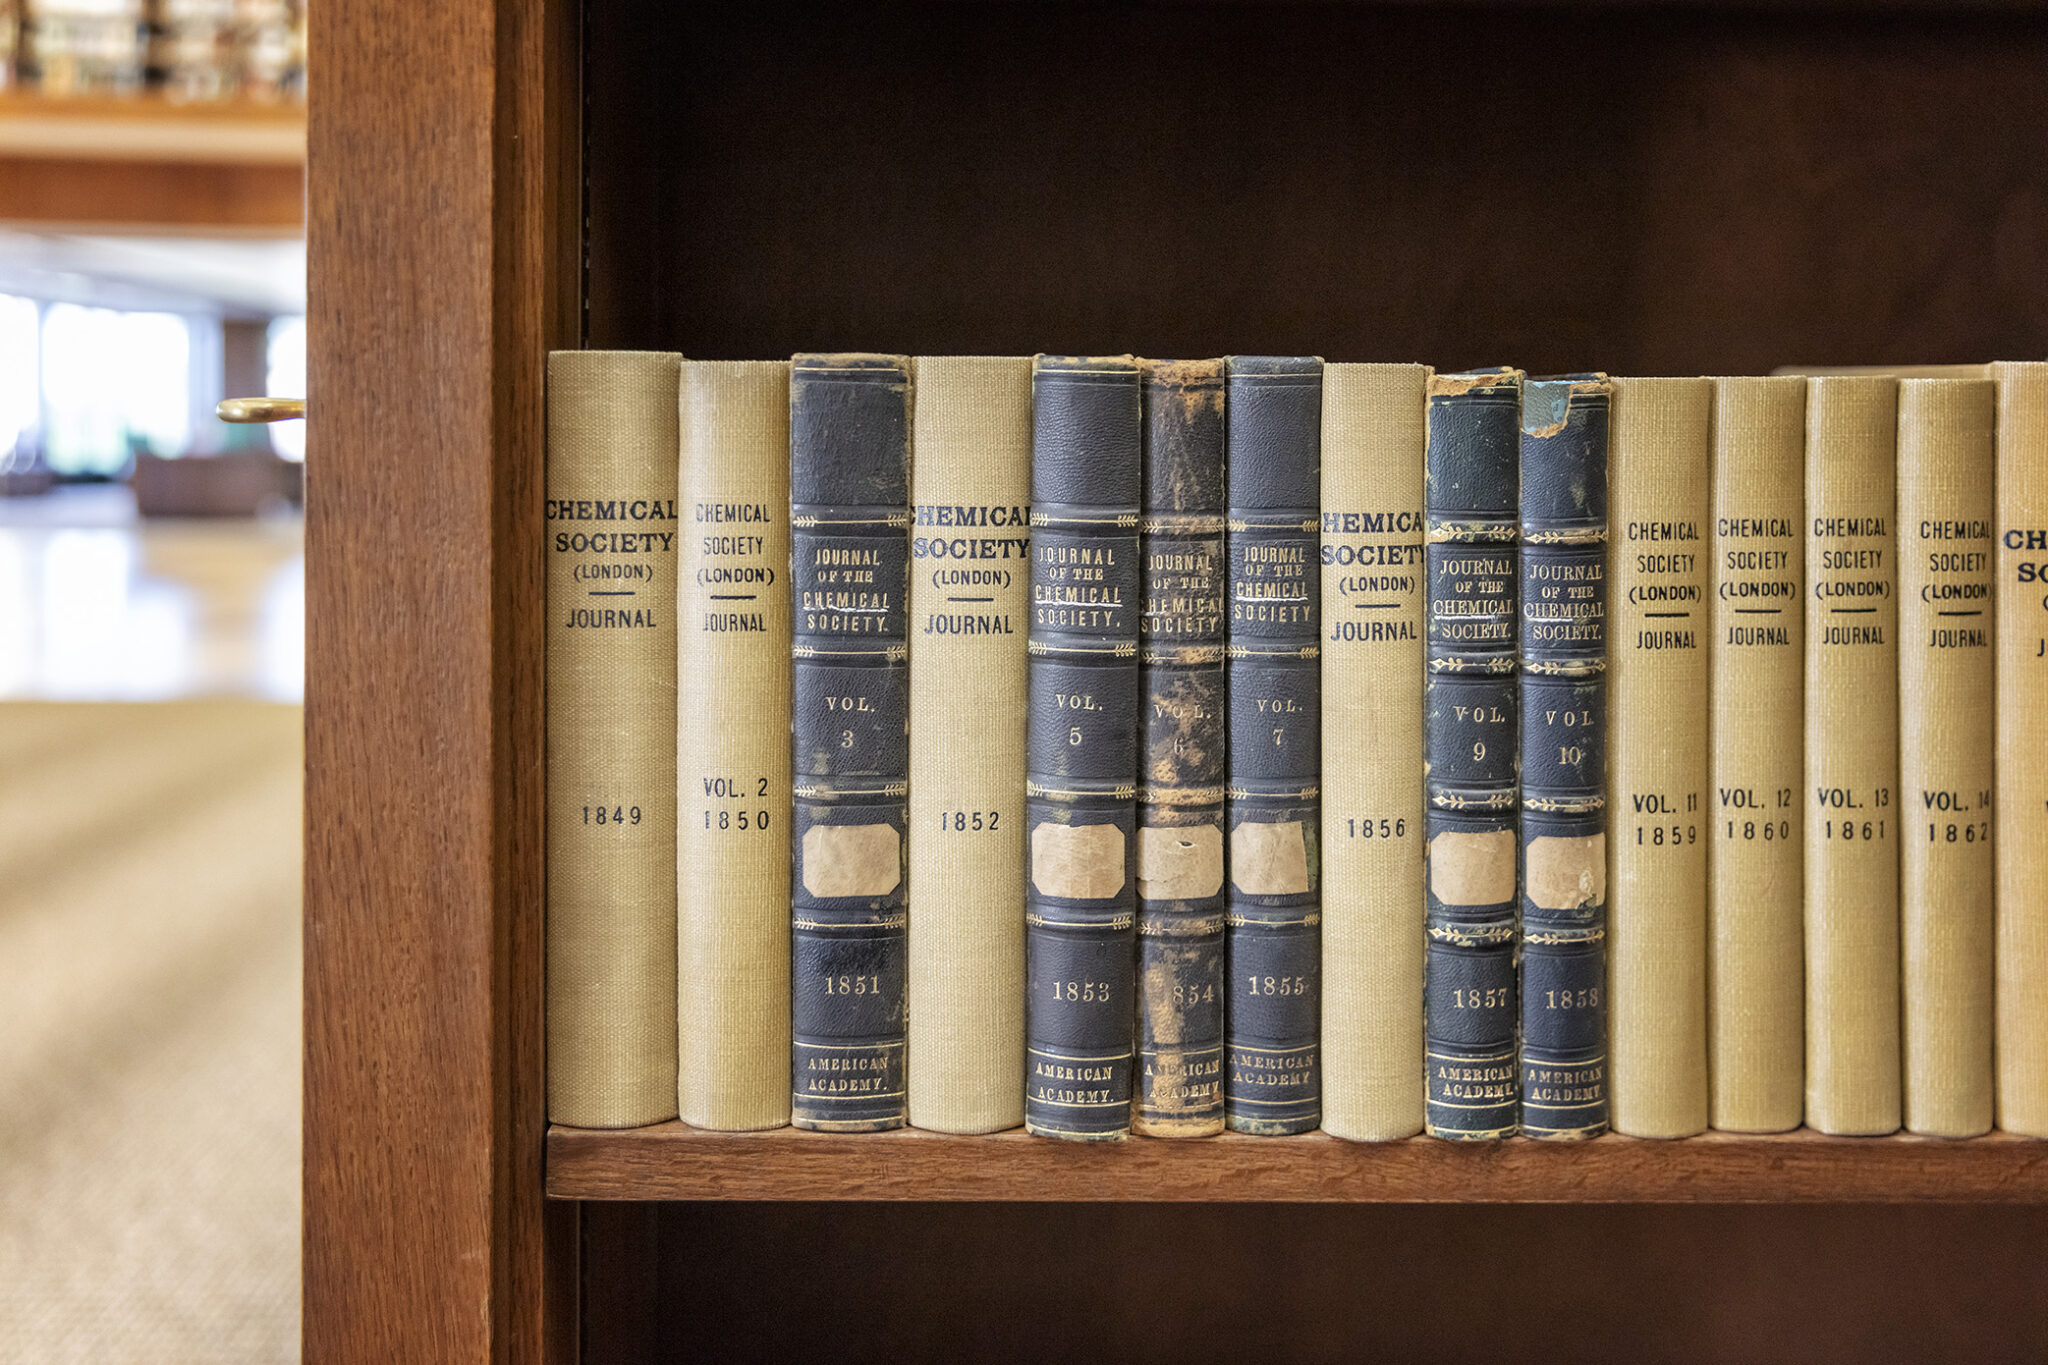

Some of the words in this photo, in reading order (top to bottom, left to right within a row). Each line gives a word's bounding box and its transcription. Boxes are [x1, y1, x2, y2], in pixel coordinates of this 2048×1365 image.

[546, 500, 678, 520] CHEMICAL
[695, 503, 771, 523] CHEMICAL
[1323, 512, 1423, 533] HEMICA
[1628, 522, 1699, 541] CHEMICAL
[1718, 518, 1794, 538] CHEMICAL
[1814, 518, 1886, 537] CHEMICAL
[1920, 521, 1990, 540] CHEMICAL
[556, 532, 674, 553] SOCIETY
[703, 536, 763, 555] SOCIETY
[913, 538, 1030, 559] SOCIETY
[815, 549, 881, 566] JOURNAL
[1039, 547, 1115, 566] JOURNAL
[1148, 555, 1213, 571] JOURNAL
[1244, 546, 1305, 563] JOURNAL
[1637, 554, 1695, 573] SOCIETY
[1727, 551, 1788, 570] SOCIETY
[1823, 550, 1883, 570] SOCIETY
[1930, 552, 1987, 573] SOCIETY
[573, 564, 653, 583] (LONDON)
[697, 567, 775, 586] (LONDON)
[1049, 566, 1067, 579] OF
[1073, 567, 1104, 581] THE
[1245, 564, 1264, 576] OF
[1274, 564, 1303, 576] THE
[1440, 559, 1513, 575] JOURNAL
[1529, 564, 1603, 581] JOURNAL
[817, 571, 839, 583] OF
[843, 571, 873, 583] THE
[932, 570, 1011, 589] (LONDON)
[1152, 578, 1171, 590] OF
[1180, 577, 1209, 590] THE
[1339, 576, 1415, 596] (LONDON)
[1035, 584, 1122, 604] CHEMICAL
[1236, 581, 1308, 598] CHEMICAL
[1455, 581, 1472, 593] OF
[1478, 581, 1504, 593] THE
[1541, 586, 1559, 599] OF
[1568, 586, 1594, 599] THE
[1629, 585, 1701, 605] (LONDON)
[1719, 581, 1796, 601] (LONDON)
[1815, 580, 1890, 600] (LONDON)
[1921, 584, 1993, 603] (LONDON)
[803, 592, 890, 609] CHEMICAL
[1433, 599, 1514, 615] CHEMICAL
[566, 609, 657, 628] JOURNAL
[1037, 608, 1121, 628] SOCIETY.
[1234, 604, 1310, 622] SOCIETY
[1523, 602, 1604, 619] CHEMICAL
[702, 613, 767, 632] JOURNAL
[807, 614, 888, 632] SOCIETY.
[924, 614, 1014, 635] JOURNAL
[1331, 621, 1417, 641] JOURNAL
[1442, 622, 1512, 640] SOCIETY.
[1532, 625, 1602, 641] SOCIETY.
[1636, 630, 1696, 649] JOURNAL
[1727, 626, 1790, 645] JOURNAL
[1823, 626, 1885, 645] JOURNAL
[1930, 629, 1988, 648] JOURNAL
[825, 696, 875, 713] VOL.
[1055, 694, 1103, 711] VOL.
[1153, 704, 1212, 719] VOL.
[1257, 699, 1303, 713] VOL.
[1453, 706, 1506, 723] VOL.
[841, 730, 854, 748] 3
[1069, 727, 1082, 746] 5
[1273, 728, 1284, 746] 7
[1173, 737, 1184, 756] 6
[1473, 742, 1486, 761] 9
[1559, 746, 1581, 765] 10
[703, 778, 745, 797] VOL.
[757, 777, 768, 797] 2
[1633, 794, 1677, 814] VOL.
[1687, 792, 1697, 812] 11
[1720, 788, 1765, 809] VOL.
[1777, 788, 1791, 808] 12
[1818, 788, 1863, 808] VOL.
[1875, 788, 1889, 807] 13
[1923, 790, 1969, 811] VOL.
[1979, 789, 1990, 809] 14
[582, 806, 641, 825] 1849
[704, 810, 769, 830] 1850
[942, 811, 999, 831] 1852
[1347, 818, 1405, 839] 1856
[1637, 825, 1696, 845] 1859
[1728, 820, 1789, 841] 1860
[1826, 820, 1884, 841] 1861
[1929, 822, 1988, 842] 1862
[825, 975, 880, 995] 1851
[1053, 980, 1110, 1002] 1853
[1173, 984, 1214, 1004] 854
[1248, 975, 1304, 996] 1855
[1453, 988, 1507, 1009] 1857
[1545, 987, 1599, 1009] 1858
[808, 1057, 888, 1071] AMERICAN
[1035, 1062, 1113, 1081] AMERICAN
[1229, 1054, 1315, 1070] AMERICAN
[1233, 1071, 1310, 1086] ACADEMY
[1438, 1065, 1513, 1082] AMERICAN
[1528, 1066, 1603, 1084] AMERICAN
[808, 1078, 888, 1092] ACADEMY.
[1037, 1086, 1115, 1103] ACADEMY.
